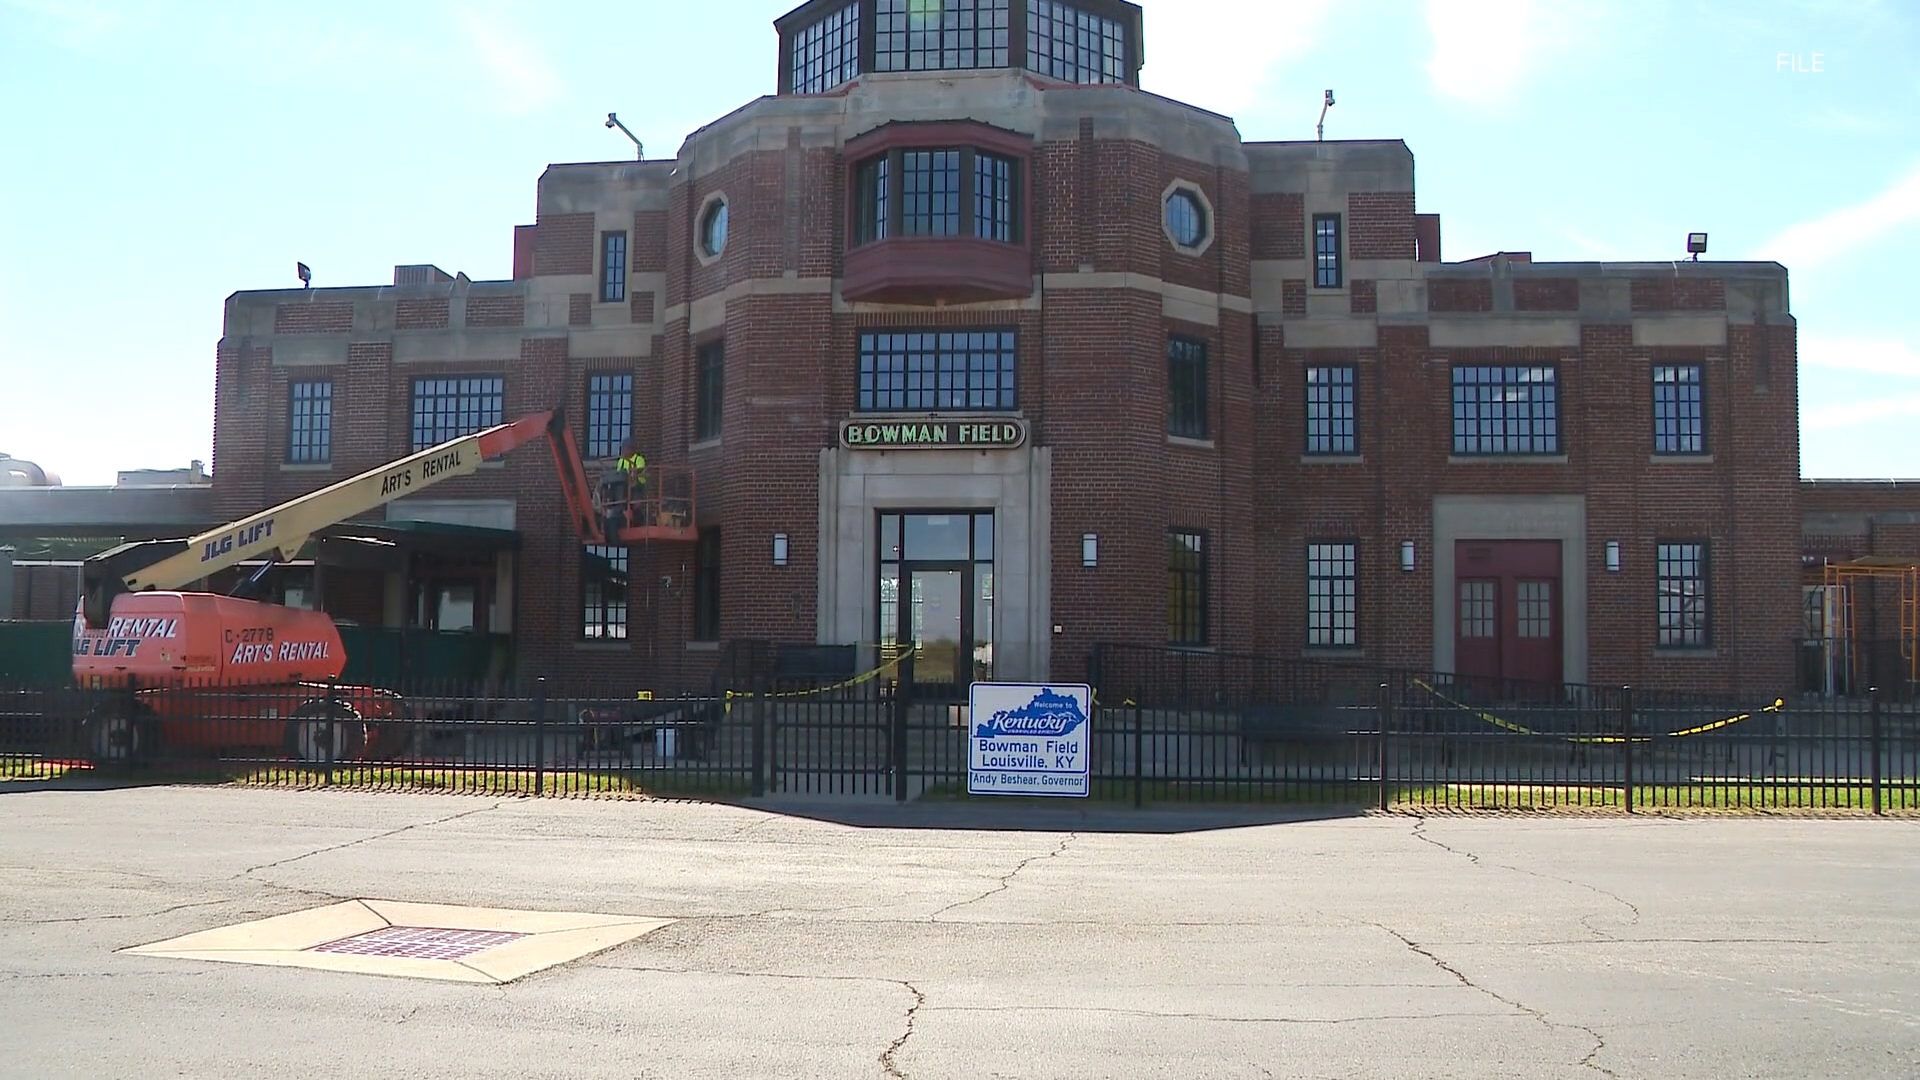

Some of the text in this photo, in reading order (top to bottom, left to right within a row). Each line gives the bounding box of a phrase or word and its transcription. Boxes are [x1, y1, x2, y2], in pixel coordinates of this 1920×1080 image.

[848, 424, 1017, 444] BOWMAN FIELD
[381, 450, 461, 497] ART'S RENTAL
[201, 519, 274, 562] JLG LIFT
[107, 617, 178, 638] RENTAL
[93, 637, 142, 657] LIFT
[231, 643, 273, 664] ART'S
[278, 641, 329, 661] RENTAL
[992, 713, 1068, 733] Kentucky
[980, 739, 1078, 754] Bowman Field
[1056, 756, 1075, 768] KY
[973, 773, 997, 786] Andy
[1042, 775, 1083, 786] Governor
